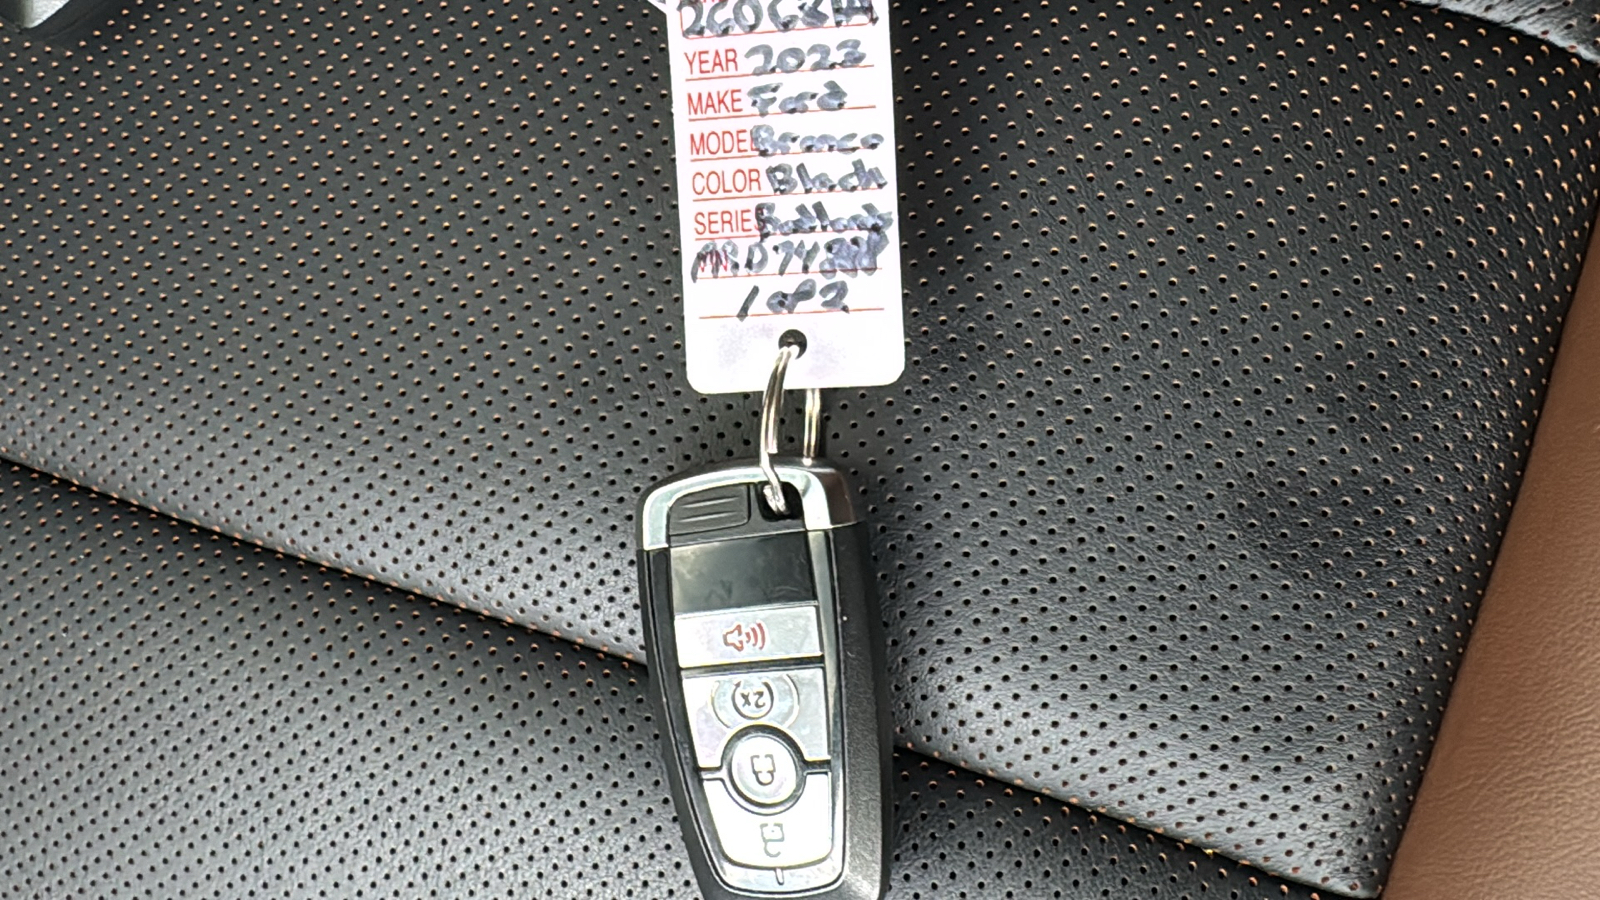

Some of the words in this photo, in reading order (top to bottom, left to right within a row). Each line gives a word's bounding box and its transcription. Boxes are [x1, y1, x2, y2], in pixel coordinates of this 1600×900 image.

[684, 48, 738, 75] YEAR
[687, 89, 743, 115] MAKE
[747, 80, 847, 117] Ford
[751, 124, 884, 158] Bronco
[692, 168, 761, 195] COLOR
[766, 158, 888, 195] Black
[736, 285, 759, 322] 1
[819, 280, 850, 314] 2
